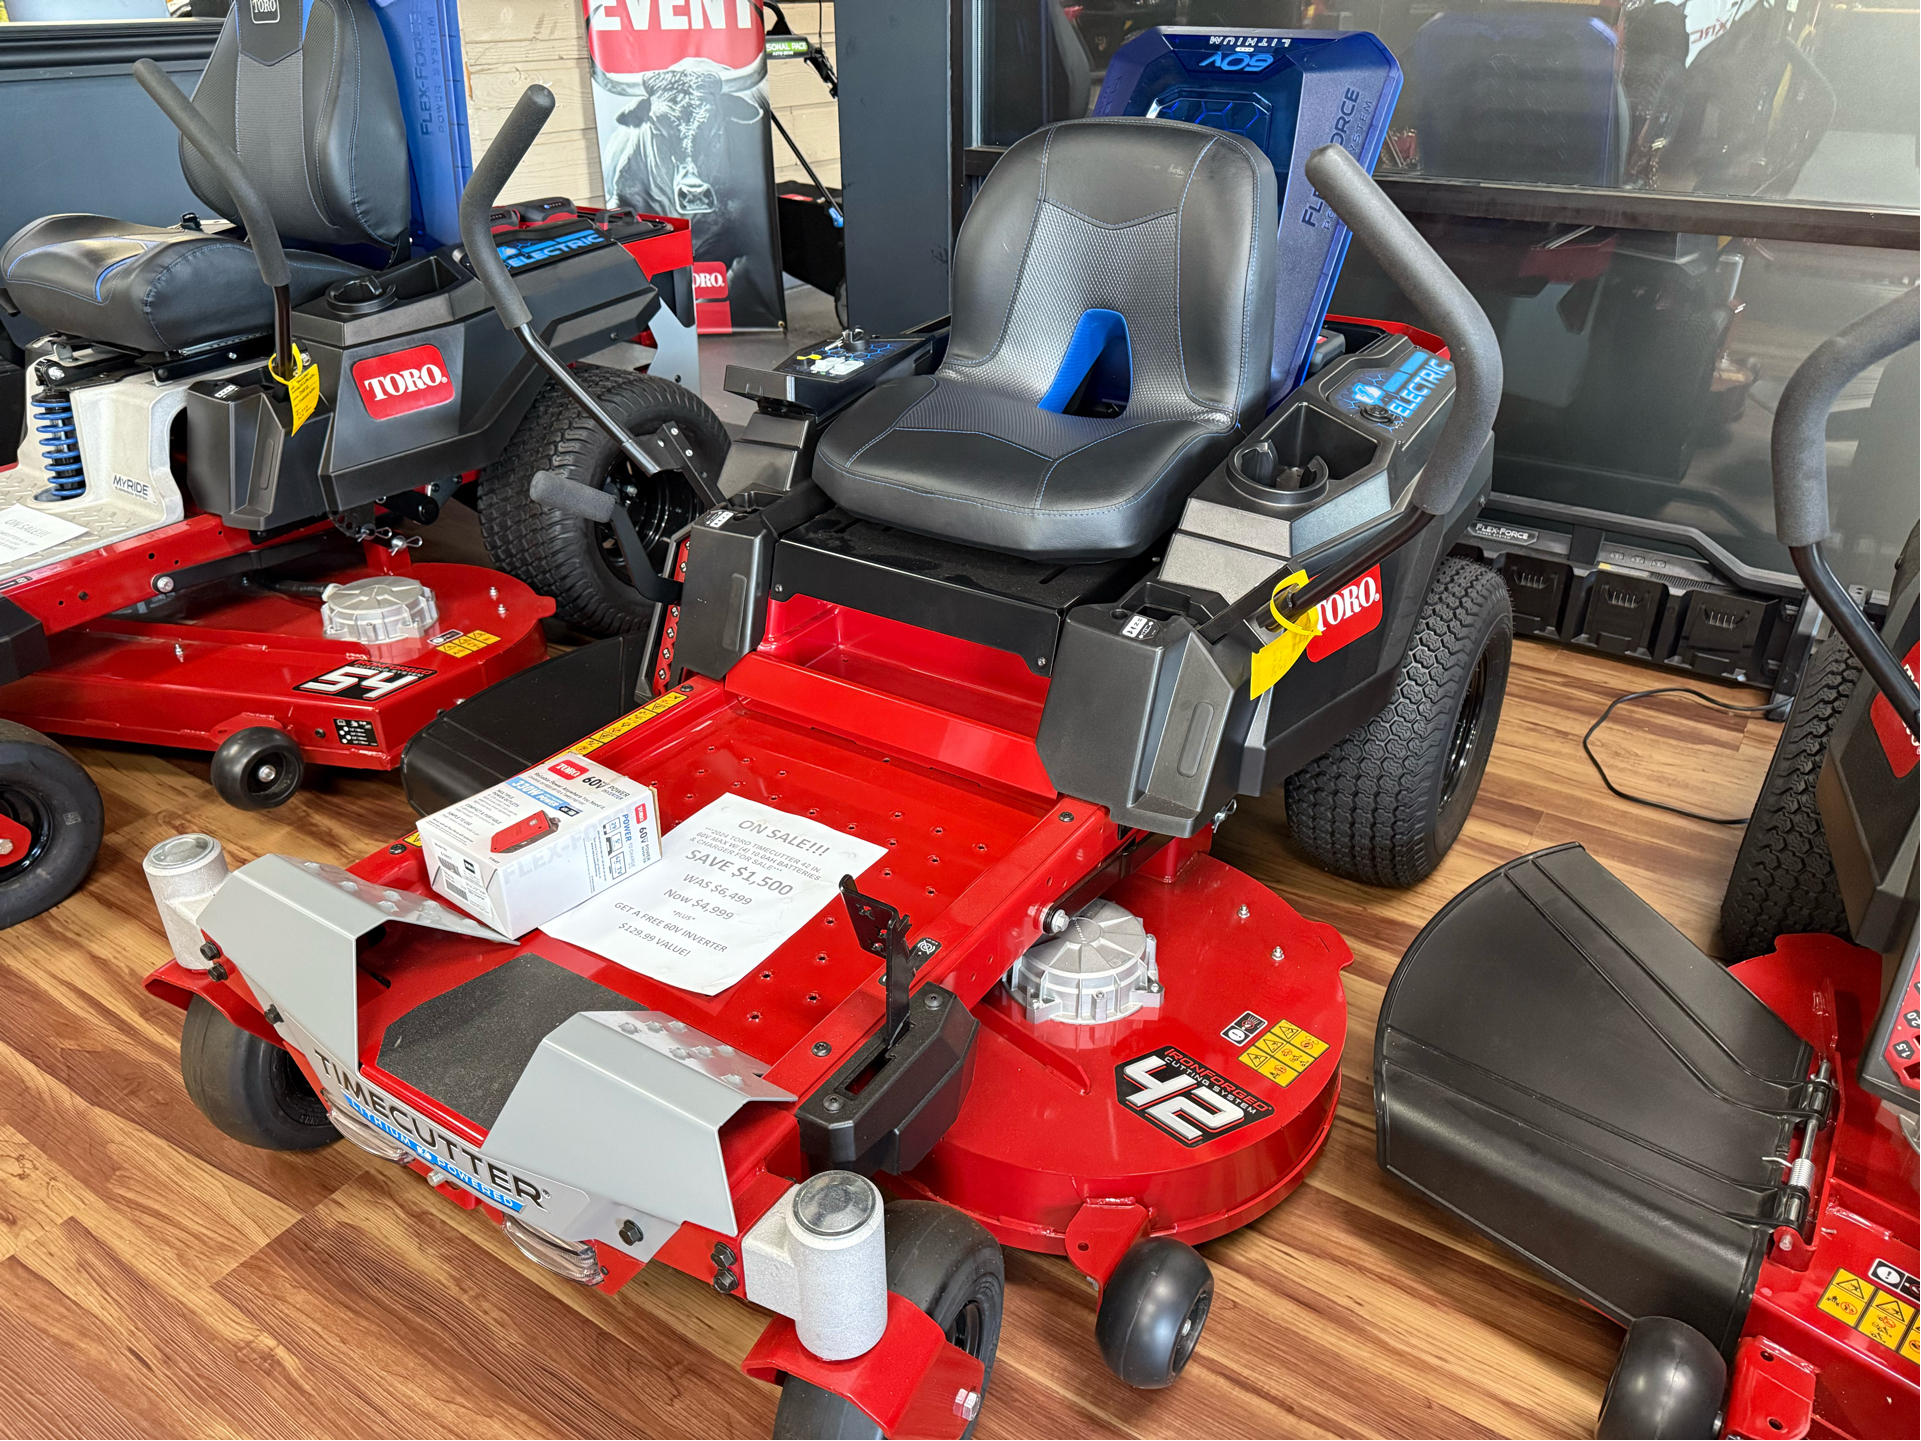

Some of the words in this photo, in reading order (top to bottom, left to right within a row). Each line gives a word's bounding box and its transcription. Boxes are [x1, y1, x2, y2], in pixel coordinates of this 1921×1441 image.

[253, 0, 278, 13] TORO
[594, 0, 752, 31] EVENT
[428, 16, 440, 76] SYSTEM
[791, 42, 807, 50] PACE
[1209, 36, 1291, 47] LITHIUM
[1200, 52, 1274, 71] 60V
[1349, 100, 1373, 152] YSTEM
[509, 232, 605, 268] ELECTRIC
[693, 273, 721, 288] ORO
[364, 364, 442, 401] TORO
[1387, 358, 1453, 418] ELECTRIC
[1476, 523, 1529, 540] FLEX-FORCE
[1317, 577, 1377, 632] TORO
[299, 666, 419, 699] 54
[555, 762, 581, 778] TORO
[582, 776, 606, 790] 60V
[608, 785, 630, 798] POWER
[512, 780, 544, 798] 330W
[538, 795, 559, 807] POWER
[622, 814, 632, 842] POWER
[738, 820, 768, 835] ON
[766, 828, 831, 857] SALE!!!
[696, 838, 735, 856] CHARGER
[734, 851, 753, 864] FOR
[696, 831, 712, 841] 60V
[712, 836, 733, 849] MAX
[741, 845, 751, 854] (4)
[750, 849, 777, 864] 10.0AH
[776, 860, 822, 881] BATTERIES
[729, 834, 752, 846] TORO
[751, 842, 801, 865] TIMECUTTER
[801, 861, 812, 869] 42
[811, 865, 821, 874] IN.
[683, 873, 712, 889] WAS
[710, 883, 753, 906] $6,499
[685, 849, 734, 872] SAVE
[731, 865, 793, 896] $1,500
[614, 902, 634, 914] GET
[640, 913, 665, 927] FREE
[663, 922, 683, 934] 60V
[681, 929, 728, 953] INVERTER
[691, 899, 734, 921] $4,999
[618, 922, 656, 942] $129.99
[655, 938, 692, 958] VALUE!
[1896, 1043, 1911, 1057] 1.5
[1124, 1055, 1244, 1140] 42
[1164, 1048, 1268, 1112] IRONFORGED
[1164, 1056, 1209, 1085] CUTTING
[1212, 1085, 1257, 1114] SYSTEM
[314, 1049, 548, 1213] TIMECUTTER
[352, 1100, 411, 1147] LITHIUM
[437, 1157, 514, 1207] POWERED
